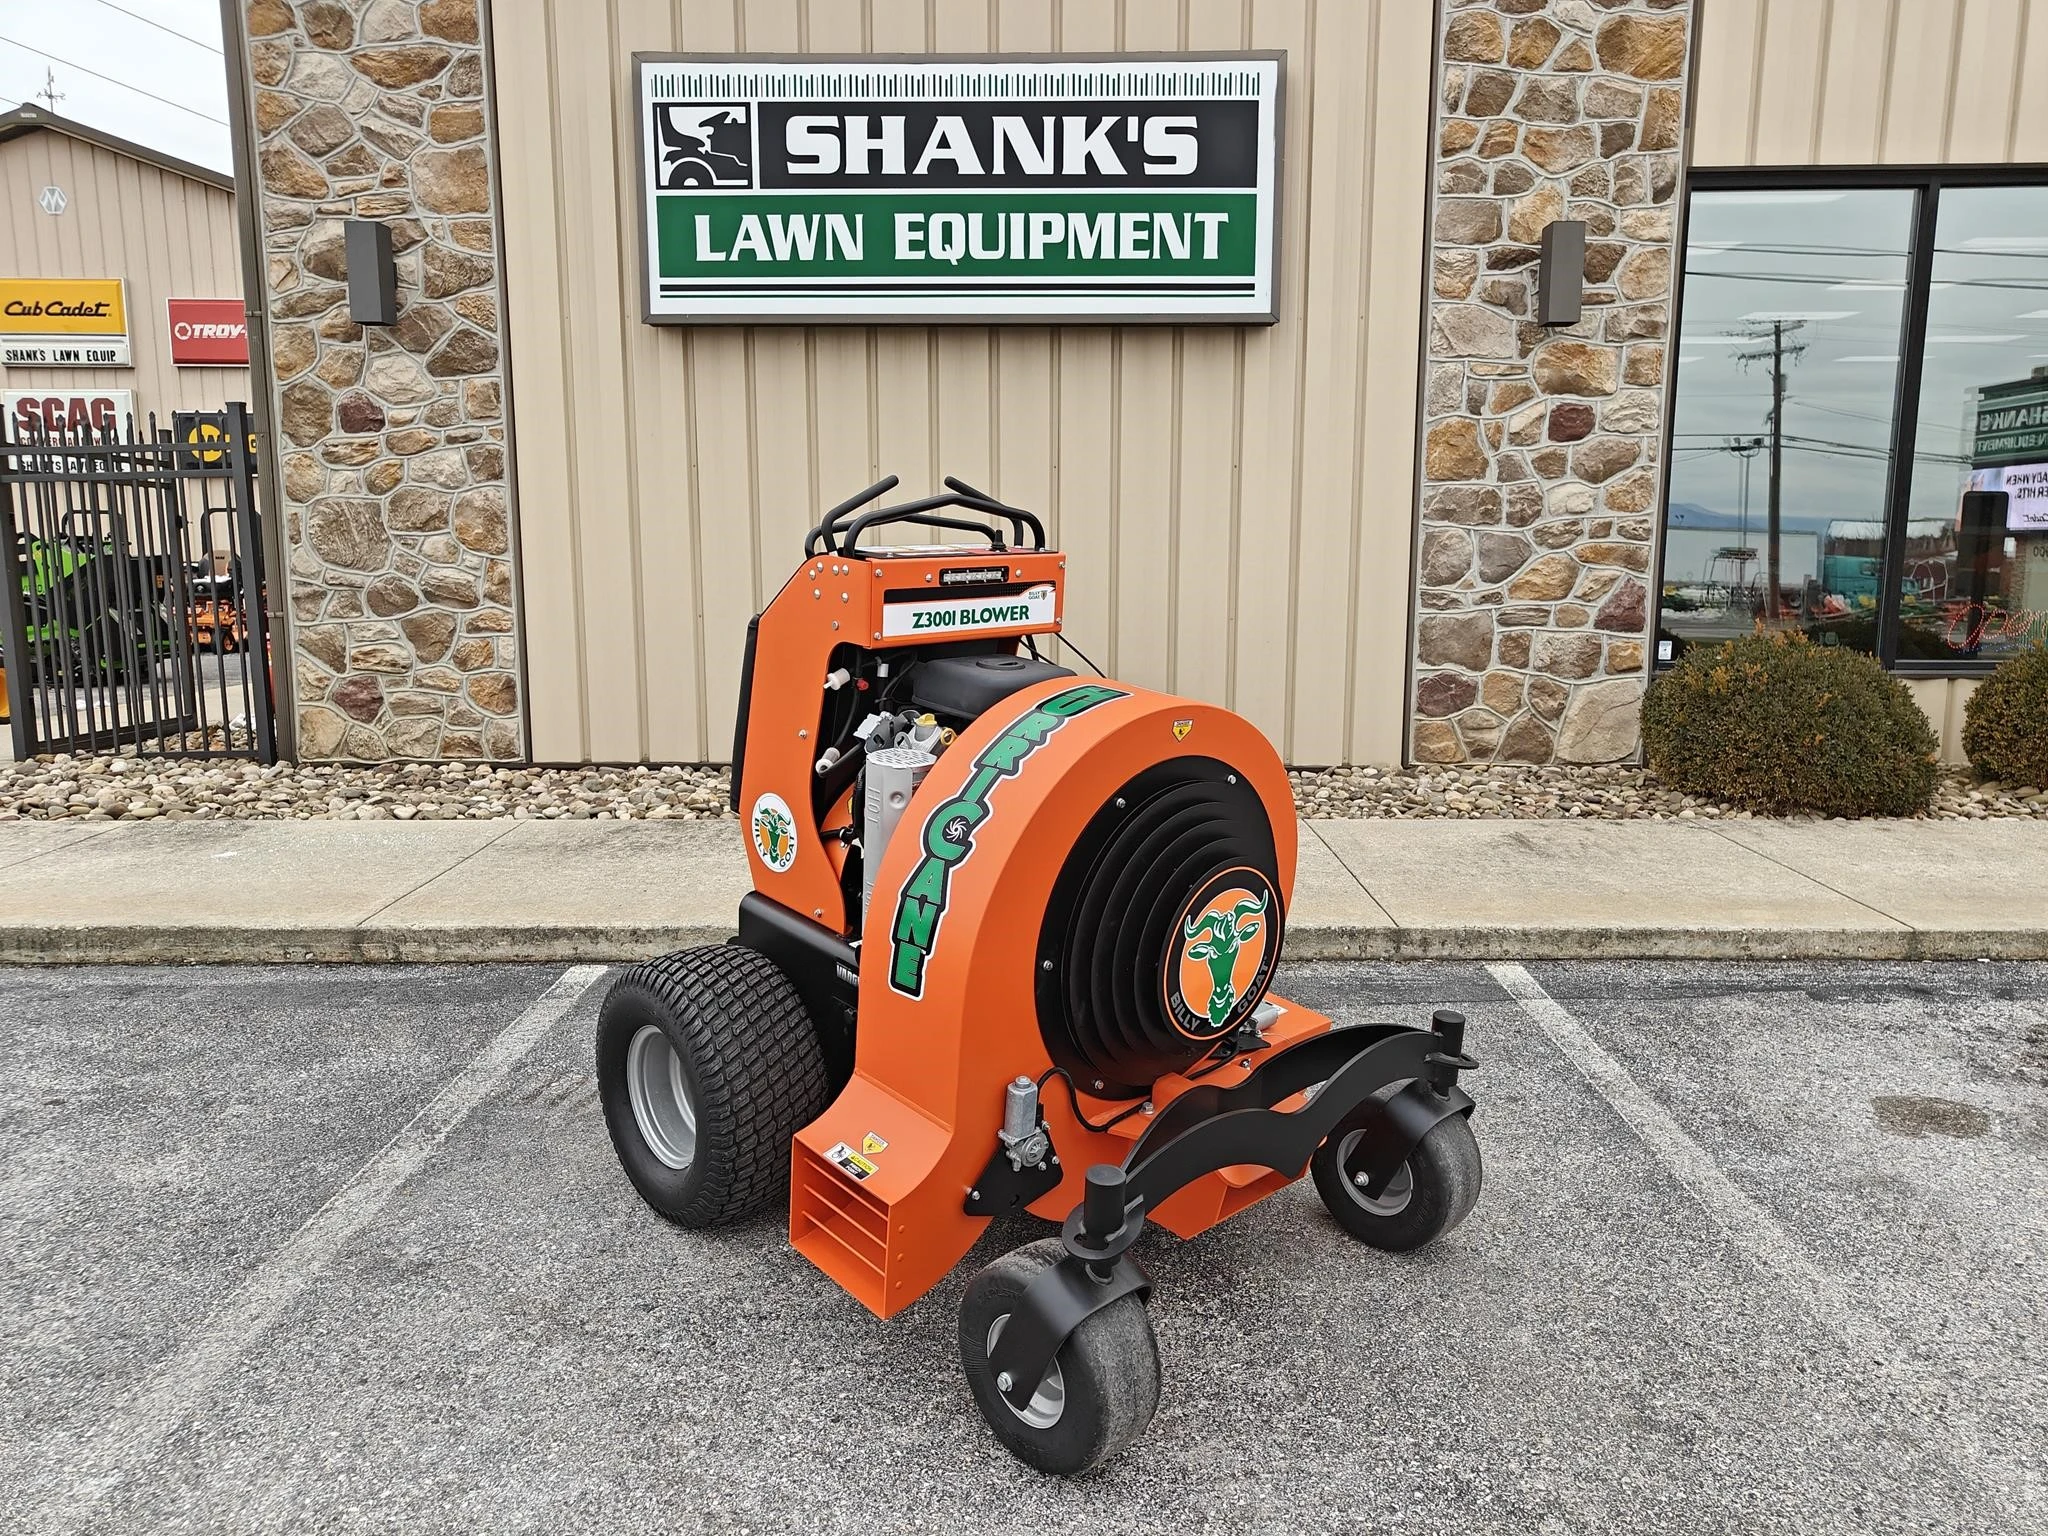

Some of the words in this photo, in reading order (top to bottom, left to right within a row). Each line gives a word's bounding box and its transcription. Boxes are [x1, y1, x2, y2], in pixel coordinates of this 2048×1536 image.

[785, 115, 1198, 176] SHANK'S
[694, 213, 864, 262] LAWN
[893, 212, 1229, 266] EQUIPMENT
[4, 301, 43, 317] Cub
[45, 301, 110, 317] Cadet
[6, 348, 46, 362] SHANK'S
[53, 349, 80, 362] LAWN
[86, 350, 116, 362] EQUIP.
[16, 397, 117, 433] SCAG
[959, 605, 1030, 628] BLOWER
[754, 817, 768, 857] BILLY
[779, 835, 795, 868] GOAT
[892, 685, 1129, 993] HURRICANE
[1170, 991, 1201, 1032] BILLY
[1237, 963, 1271, 1014] GOAT
